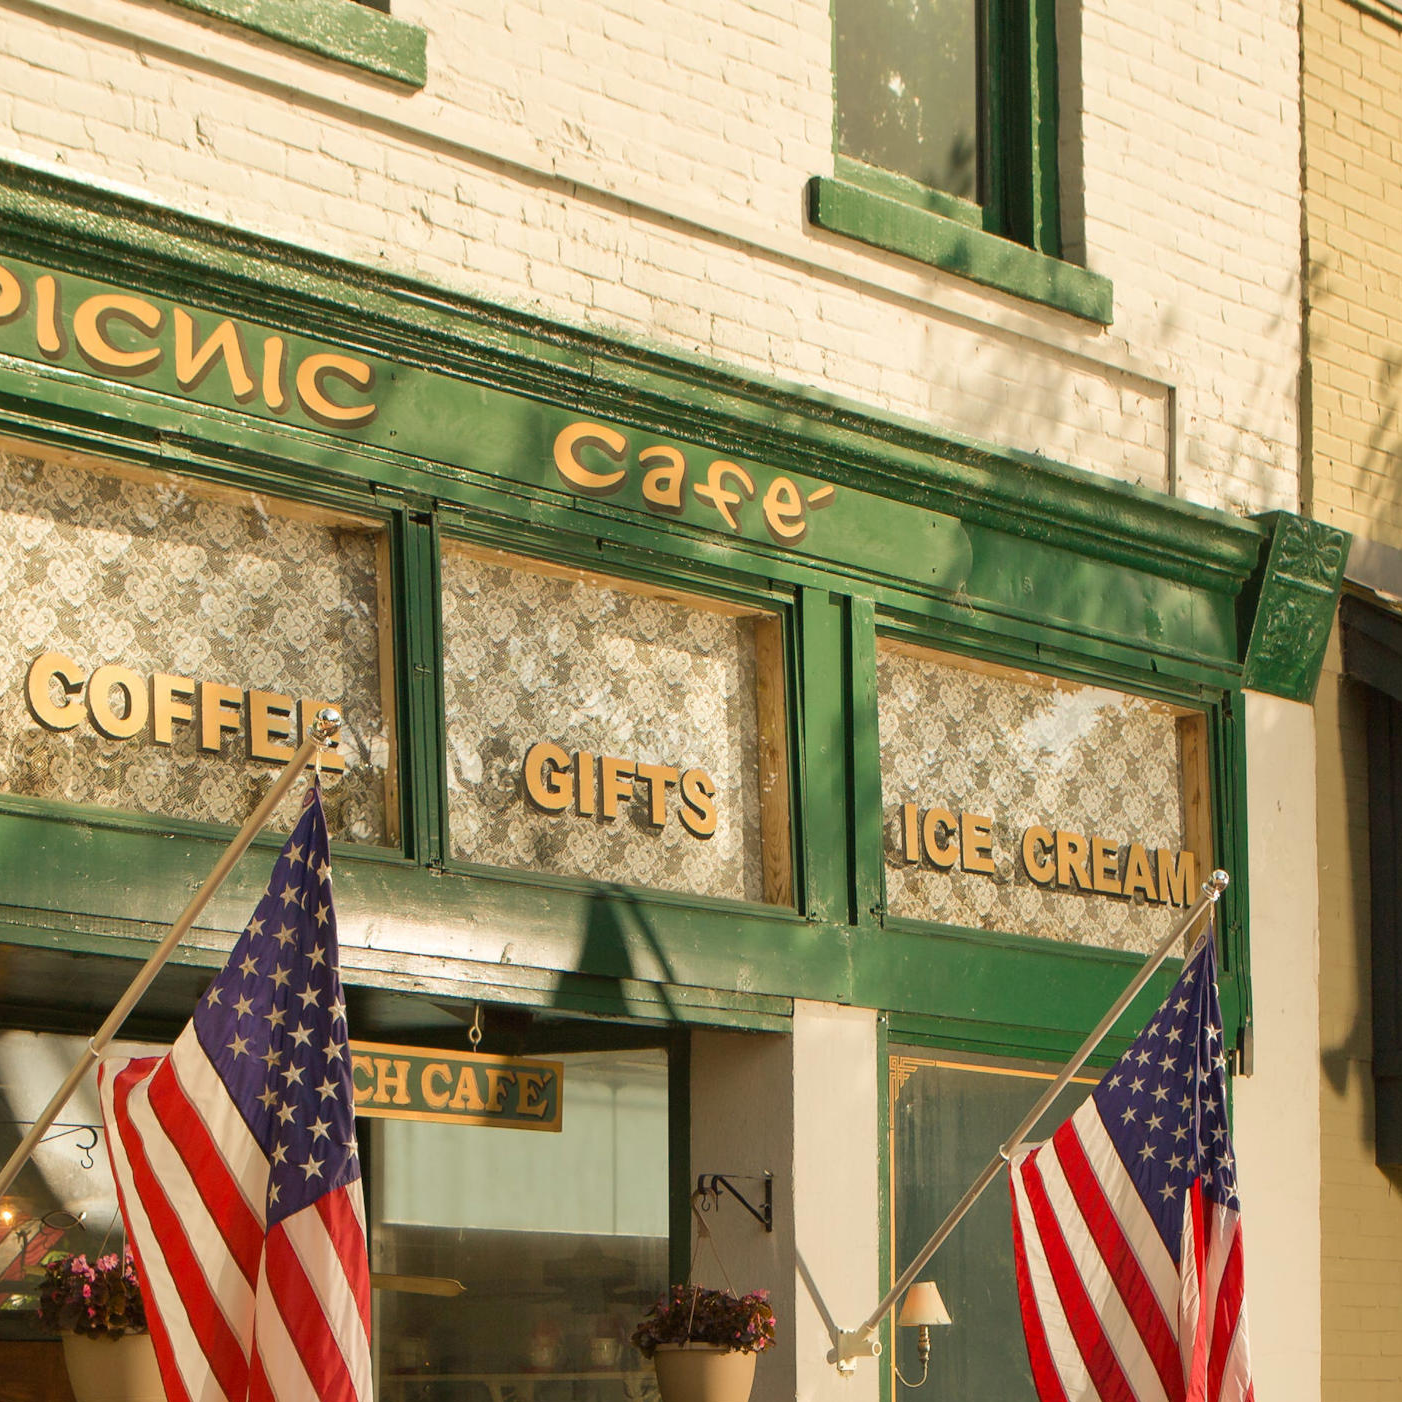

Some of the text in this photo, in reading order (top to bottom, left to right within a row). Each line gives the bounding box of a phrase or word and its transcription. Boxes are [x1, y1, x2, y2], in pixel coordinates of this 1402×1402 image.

[523, 742, 718, 840] GIFTS
[901, 801, 1197, 908] ICE CREAM
